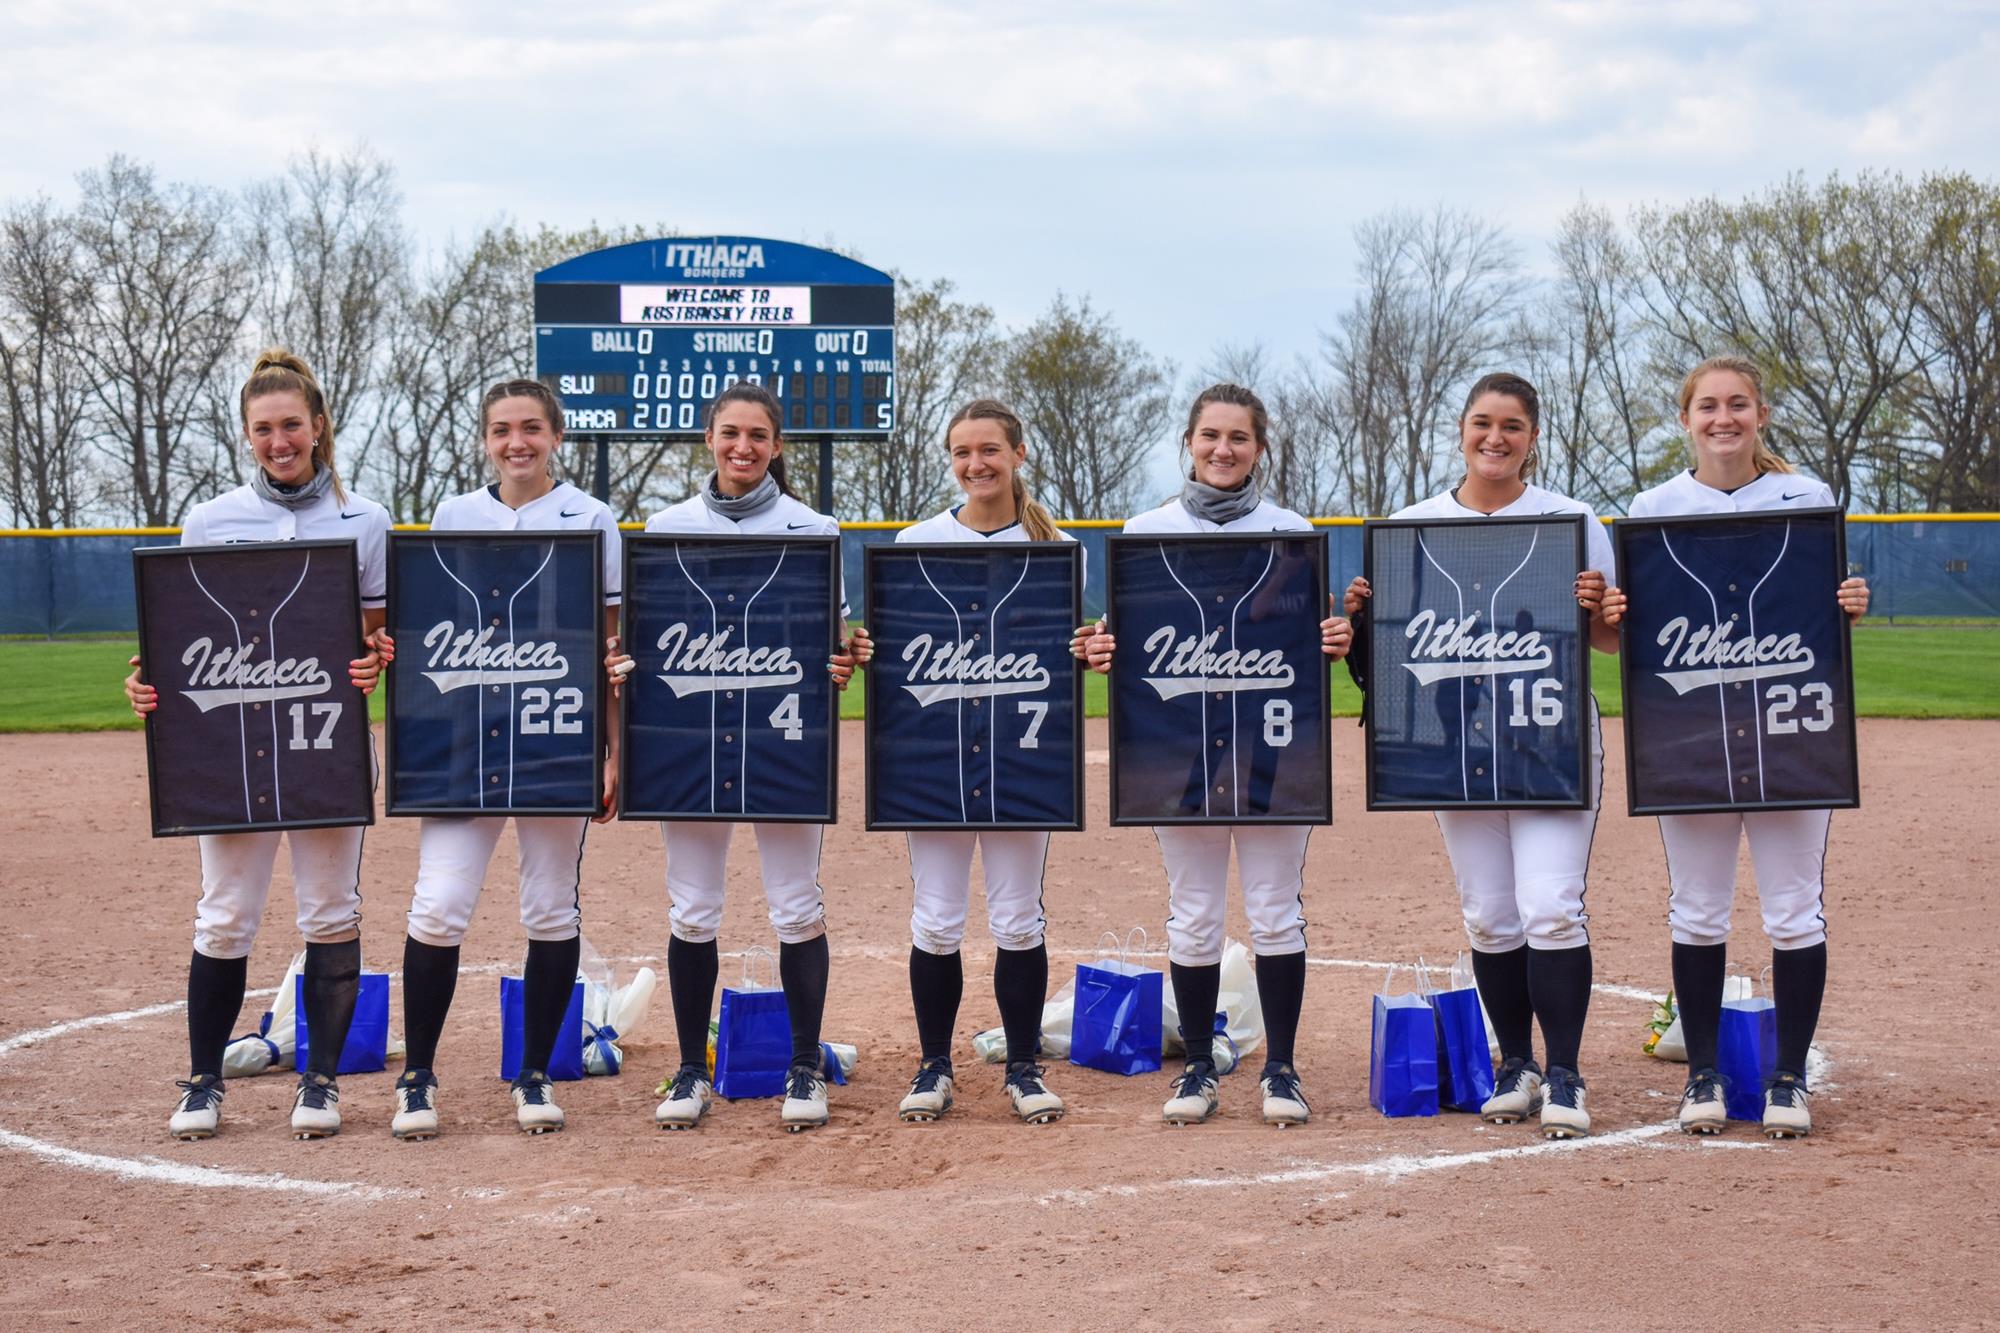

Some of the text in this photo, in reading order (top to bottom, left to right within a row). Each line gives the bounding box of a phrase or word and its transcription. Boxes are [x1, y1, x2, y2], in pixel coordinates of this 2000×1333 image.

[665, 244, 765, 268] ITHACA
[683, 267, 745, 278] BOMBERS
[591, 329, 653, 354] BALL 0
[693, 330, 773, 355] STRIKE 0
[815, 330, 868, 355] OUT 0
[559, 375, 595, 395] SLU
[638, 359, 892, 373] 1 2 3 4 5 6 7 8 9 10 TOTAL
[562, 408, 617, 429] THACA
[424, 620, 568, 678] Ithaca
[657, 622, 803, 684] Ithaca
[902, 633, 1050, 690] Ithaca
[1144, 625, 1294, 687] Ithaca
[1405, 609, 1552, 668] Ithaca
[1657, 616, 1814, 671] Ithaca
[181, 637, 331, 693] Ithaca
[289, 702, 343, 750] 17
[520, 687, 583, 735] 22
[768, 693, 803, 740] 4
[1018, 701, 1049, 749] 7
[1263, 699, 1293, 747] 8
[1508, 678, 1563, 727] 16
[1766, 682, 1834, 735] 23
